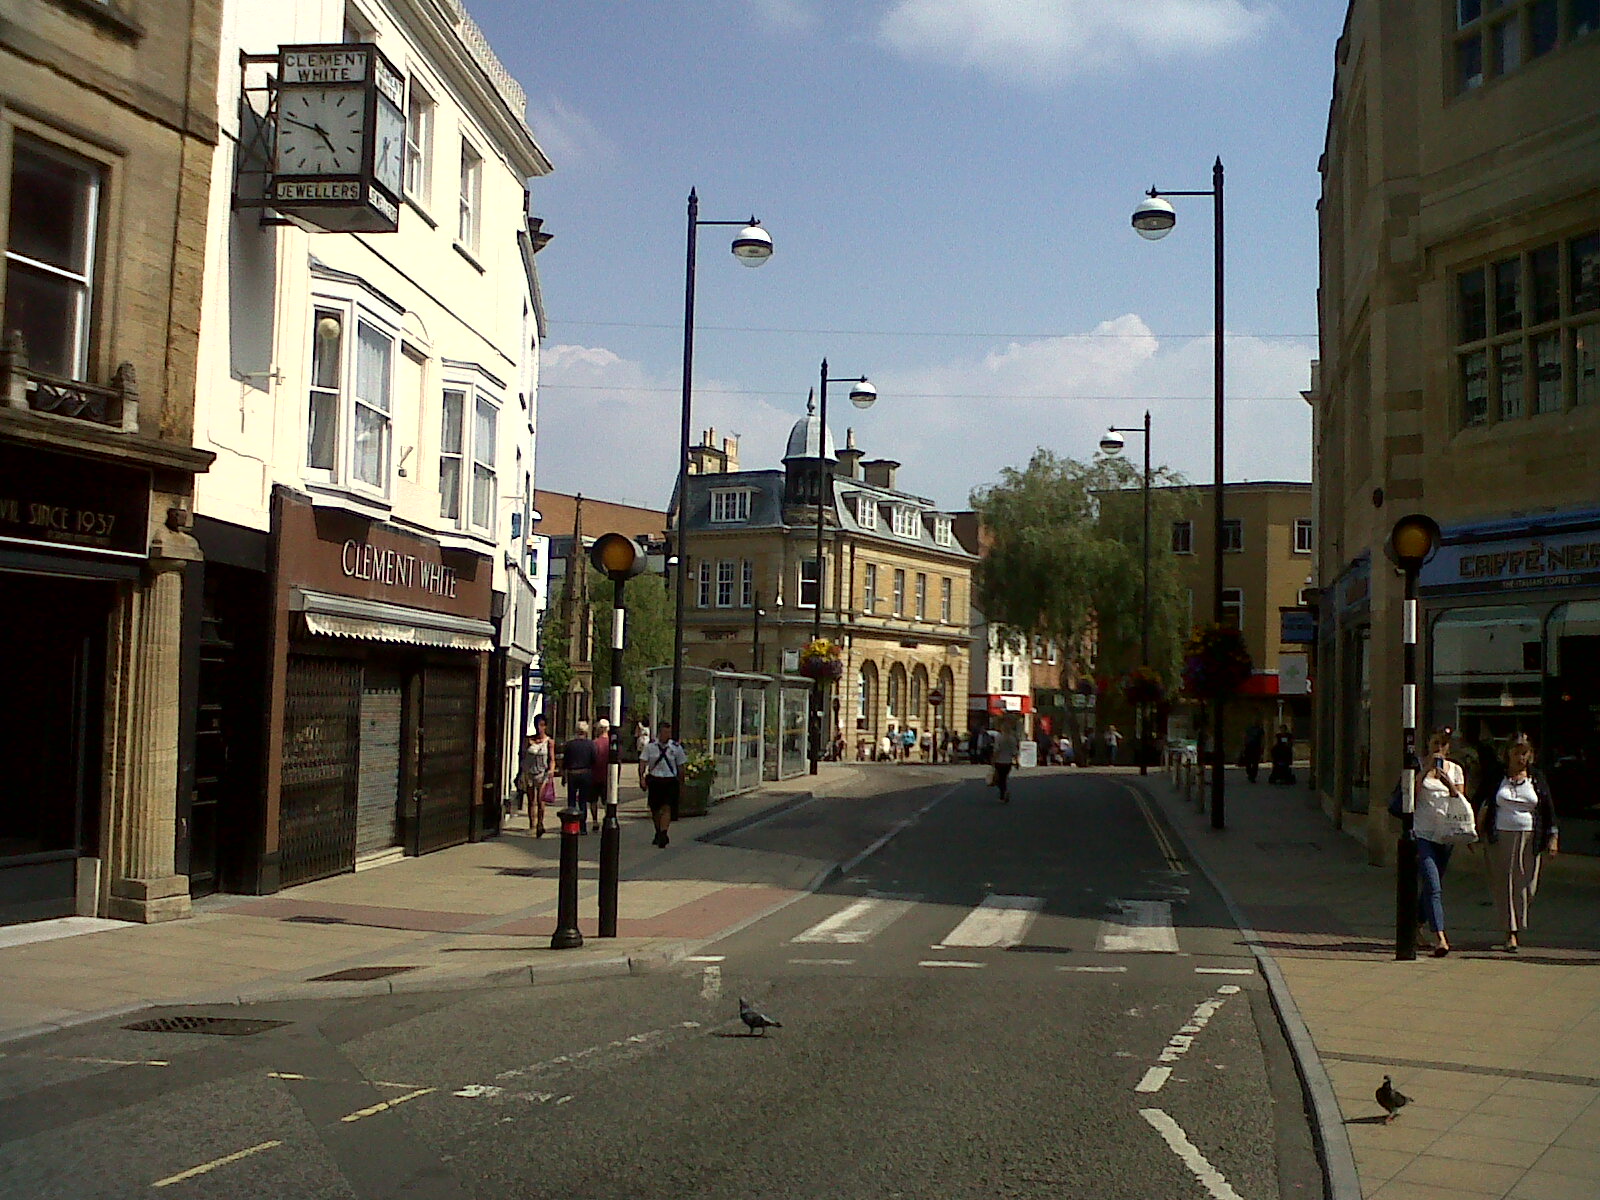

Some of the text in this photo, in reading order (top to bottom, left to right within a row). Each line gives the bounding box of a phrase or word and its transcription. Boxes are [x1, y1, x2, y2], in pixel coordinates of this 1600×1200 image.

[286, 53, 366, 67] CLEMENT
[298, 68, 349, 82] WHITE
[278, 185, 359, 199] JEWELLERS
[28, 503, 69, 529] SINCE
[76, 510, 116, 536] 1937
[341, 539, 457, 599] CLEMENT WHITE
